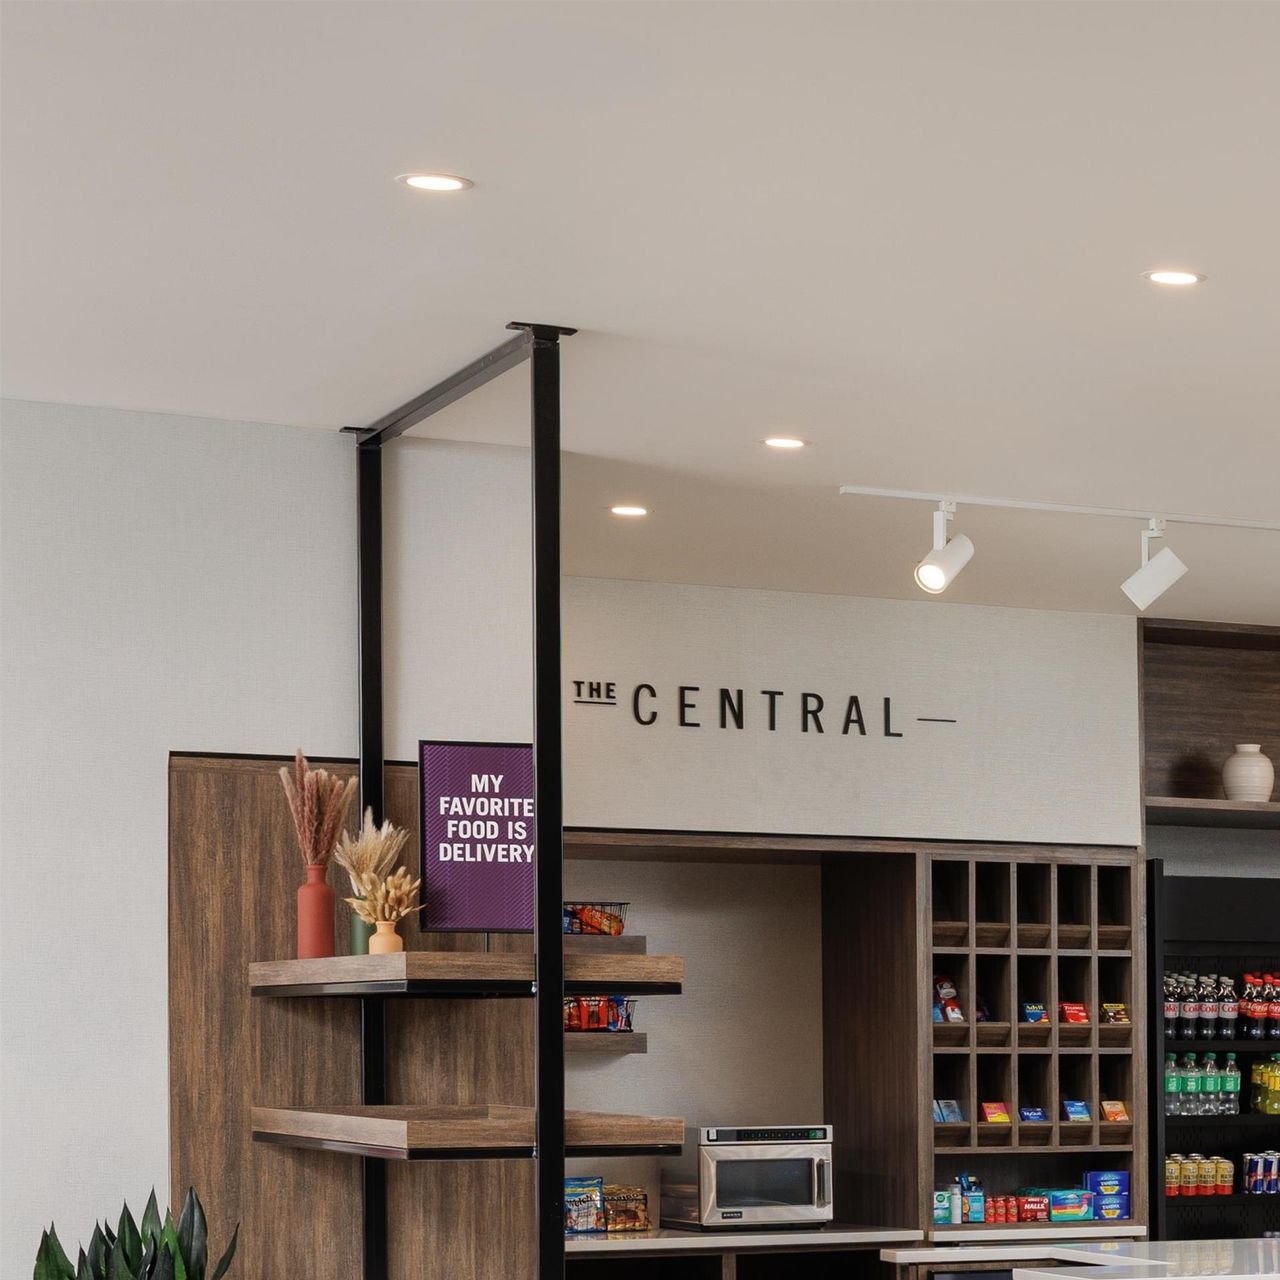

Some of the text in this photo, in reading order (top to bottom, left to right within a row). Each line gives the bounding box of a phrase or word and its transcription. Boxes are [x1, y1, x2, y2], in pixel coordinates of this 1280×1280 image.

[573, 680, 904, 738] THE CENTRAL
[471, 774, 504, 793] MY
[440, 796, 535, 817] FAVORITE
[447, 820, 527, 840] FOOD IS
[439, 842, 535, 863] DELIVERY
